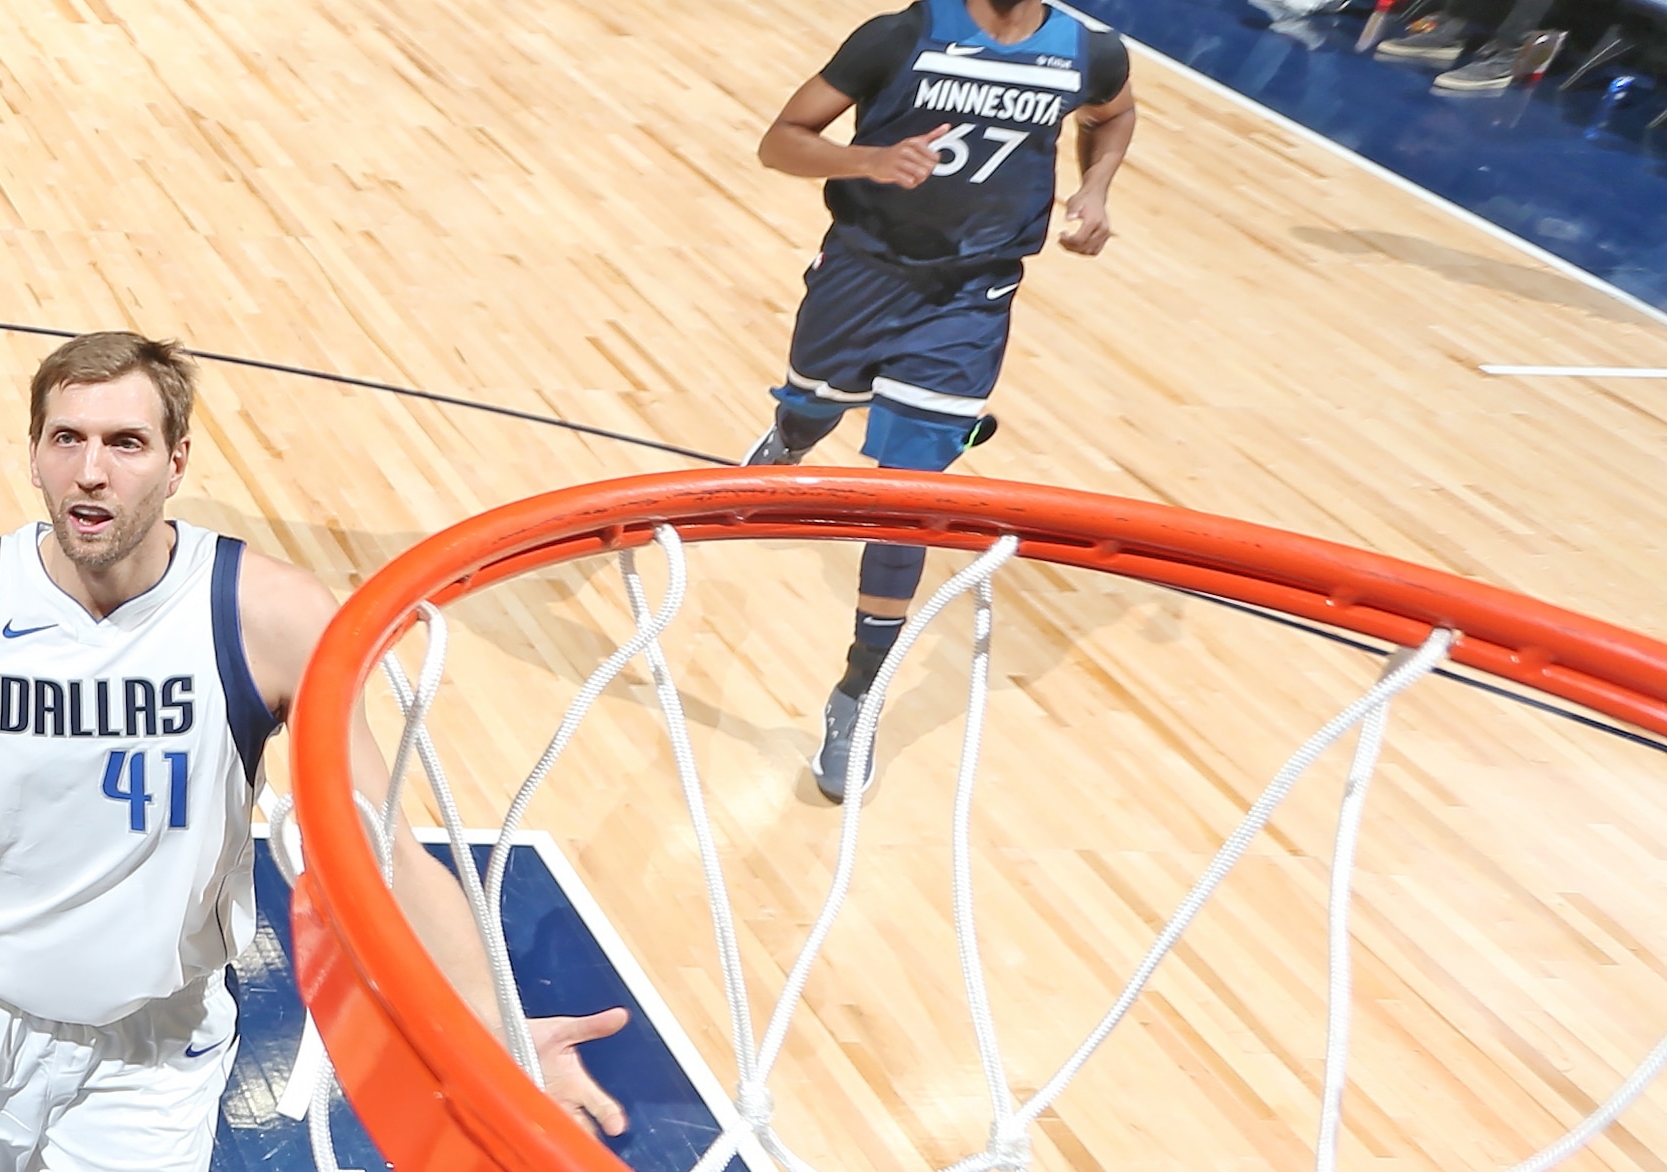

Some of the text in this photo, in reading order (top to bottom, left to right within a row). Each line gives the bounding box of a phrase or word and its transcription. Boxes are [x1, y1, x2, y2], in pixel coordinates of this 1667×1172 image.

[913, 77, 1063, 126] MINNESOTA
[927, 123, 1031, 184] 67
[100, 748, 190, 832] 41
